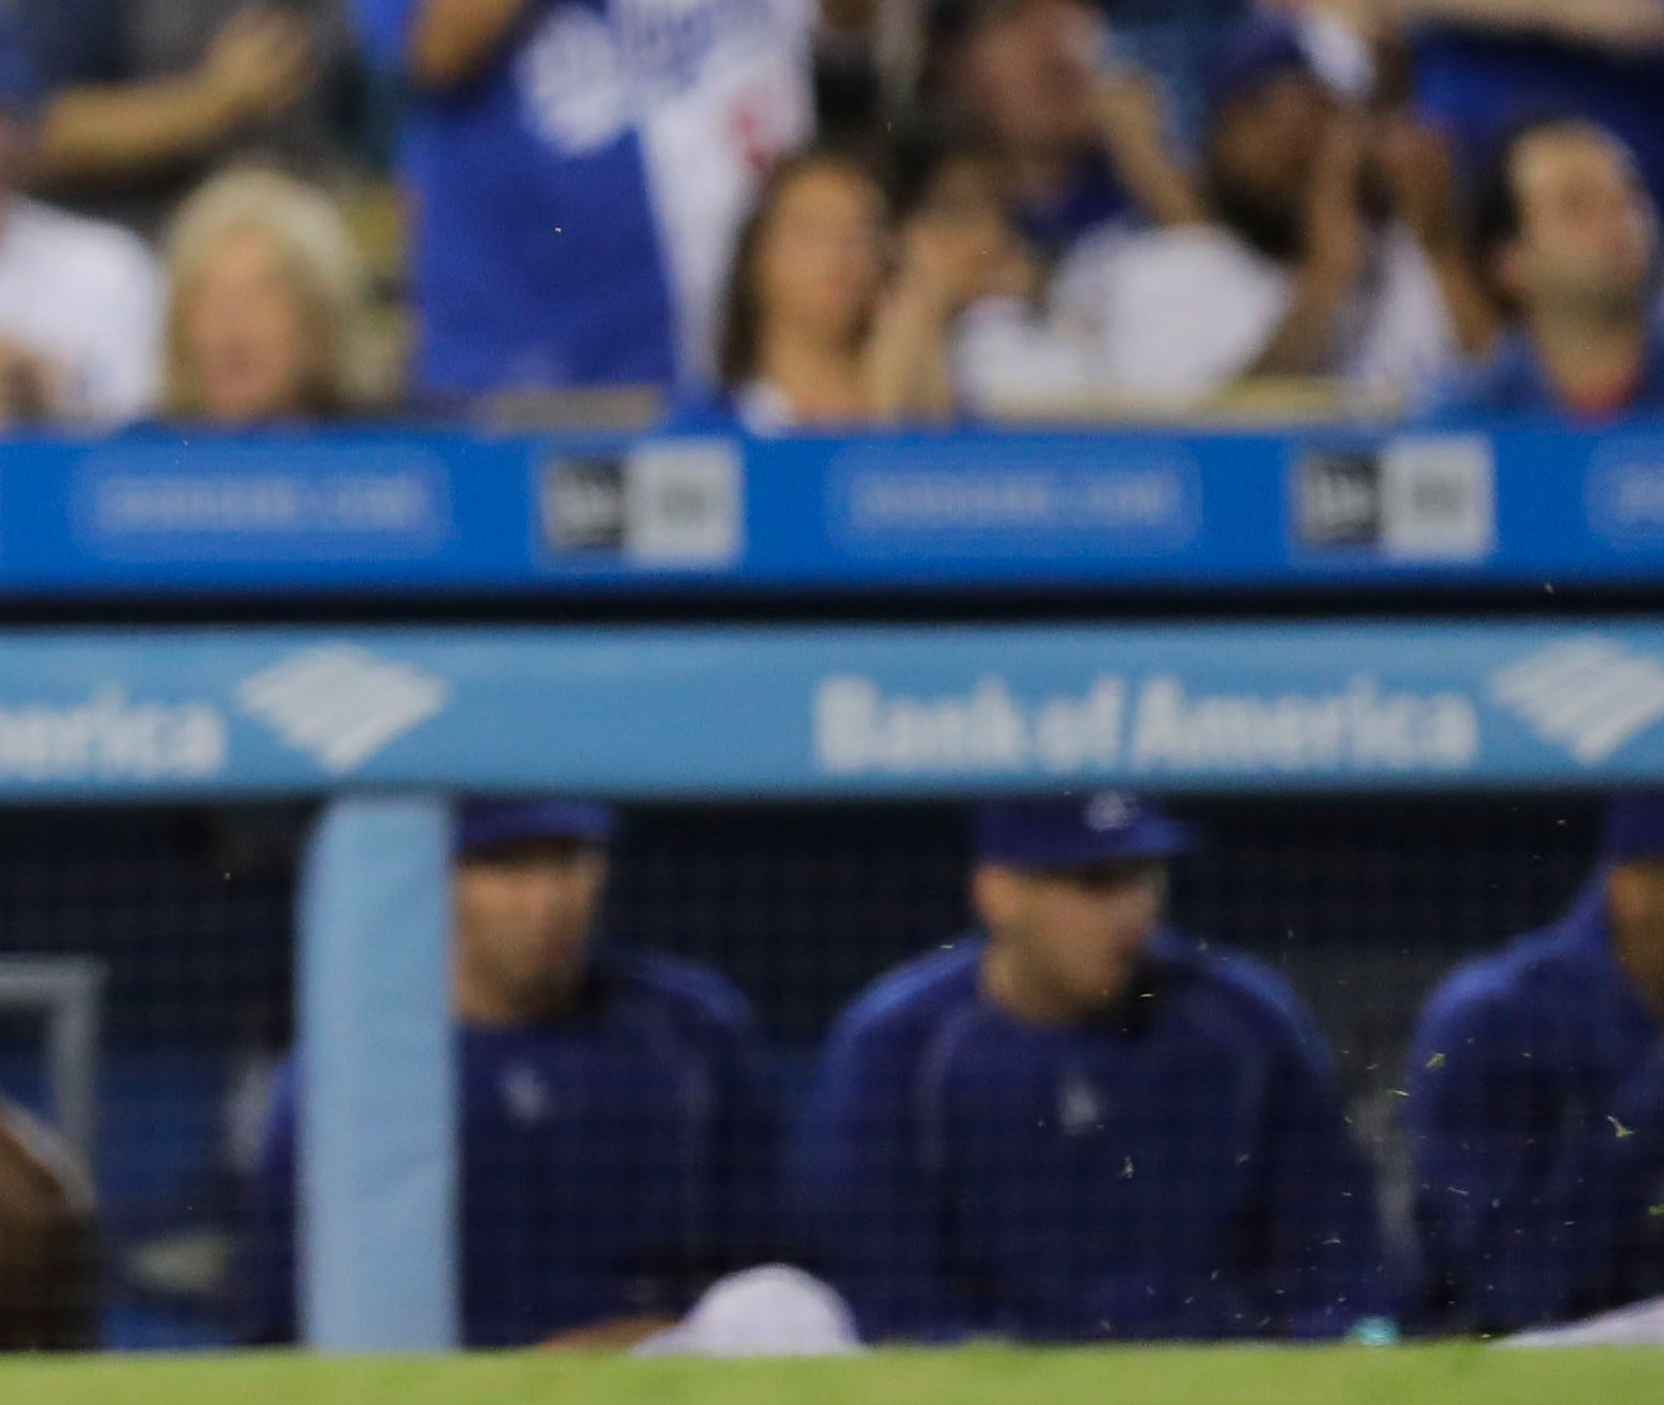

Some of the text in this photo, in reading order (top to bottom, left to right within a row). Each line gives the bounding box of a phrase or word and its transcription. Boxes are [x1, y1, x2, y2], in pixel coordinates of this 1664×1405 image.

[813, 673, 1477, 773] Bank of America
